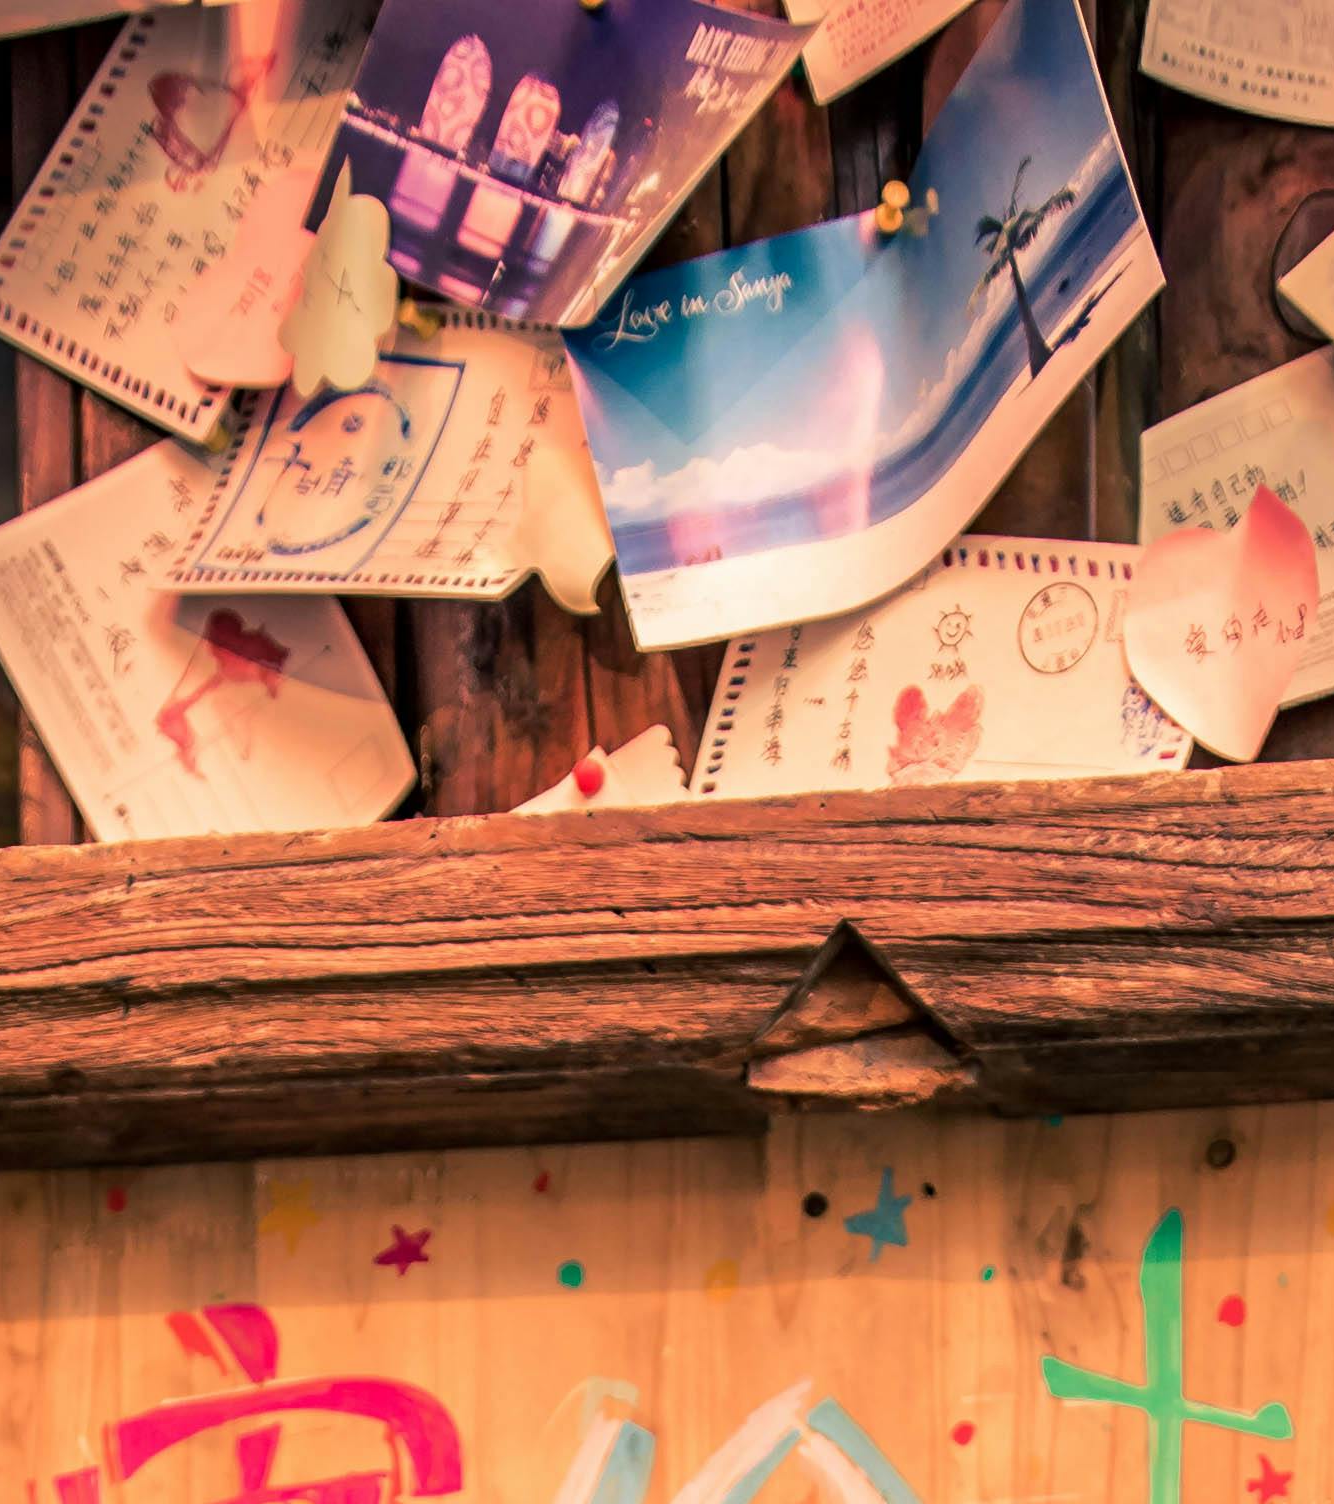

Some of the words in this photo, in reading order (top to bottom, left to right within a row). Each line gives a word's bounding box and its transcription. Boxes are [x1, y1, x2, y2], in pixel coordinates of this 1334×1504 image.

[595, 288, 671, 350] Love
[681, 294, 708, 316] in
[713, 266, 794, 313] Sanya
